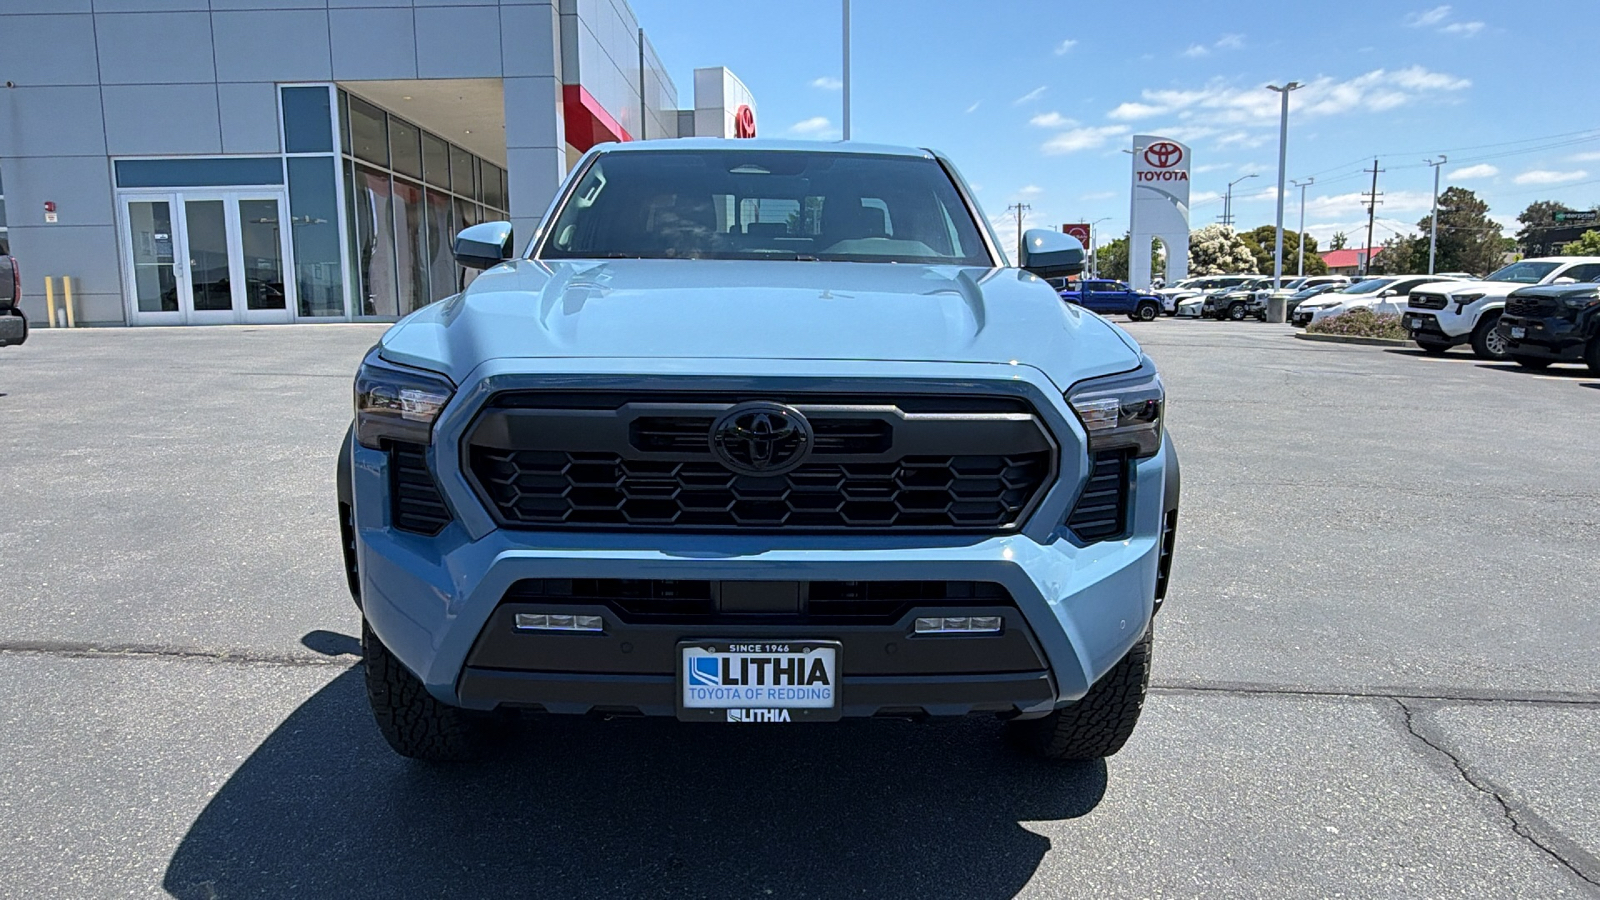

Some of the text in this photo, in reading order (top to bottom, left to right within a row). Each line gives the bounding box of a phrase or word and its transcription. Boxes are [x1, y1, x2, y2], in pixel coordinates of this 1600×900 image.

[1136, 171, 1188, 181] TOYOTA
[729, 644, 790, 652] SINCE 1946
[721, 657, 831, 686] LITHIA
[689, 688, 831, 700] TOYOTA OF REDDING
[741, 709, 791, 722] LITHIA
